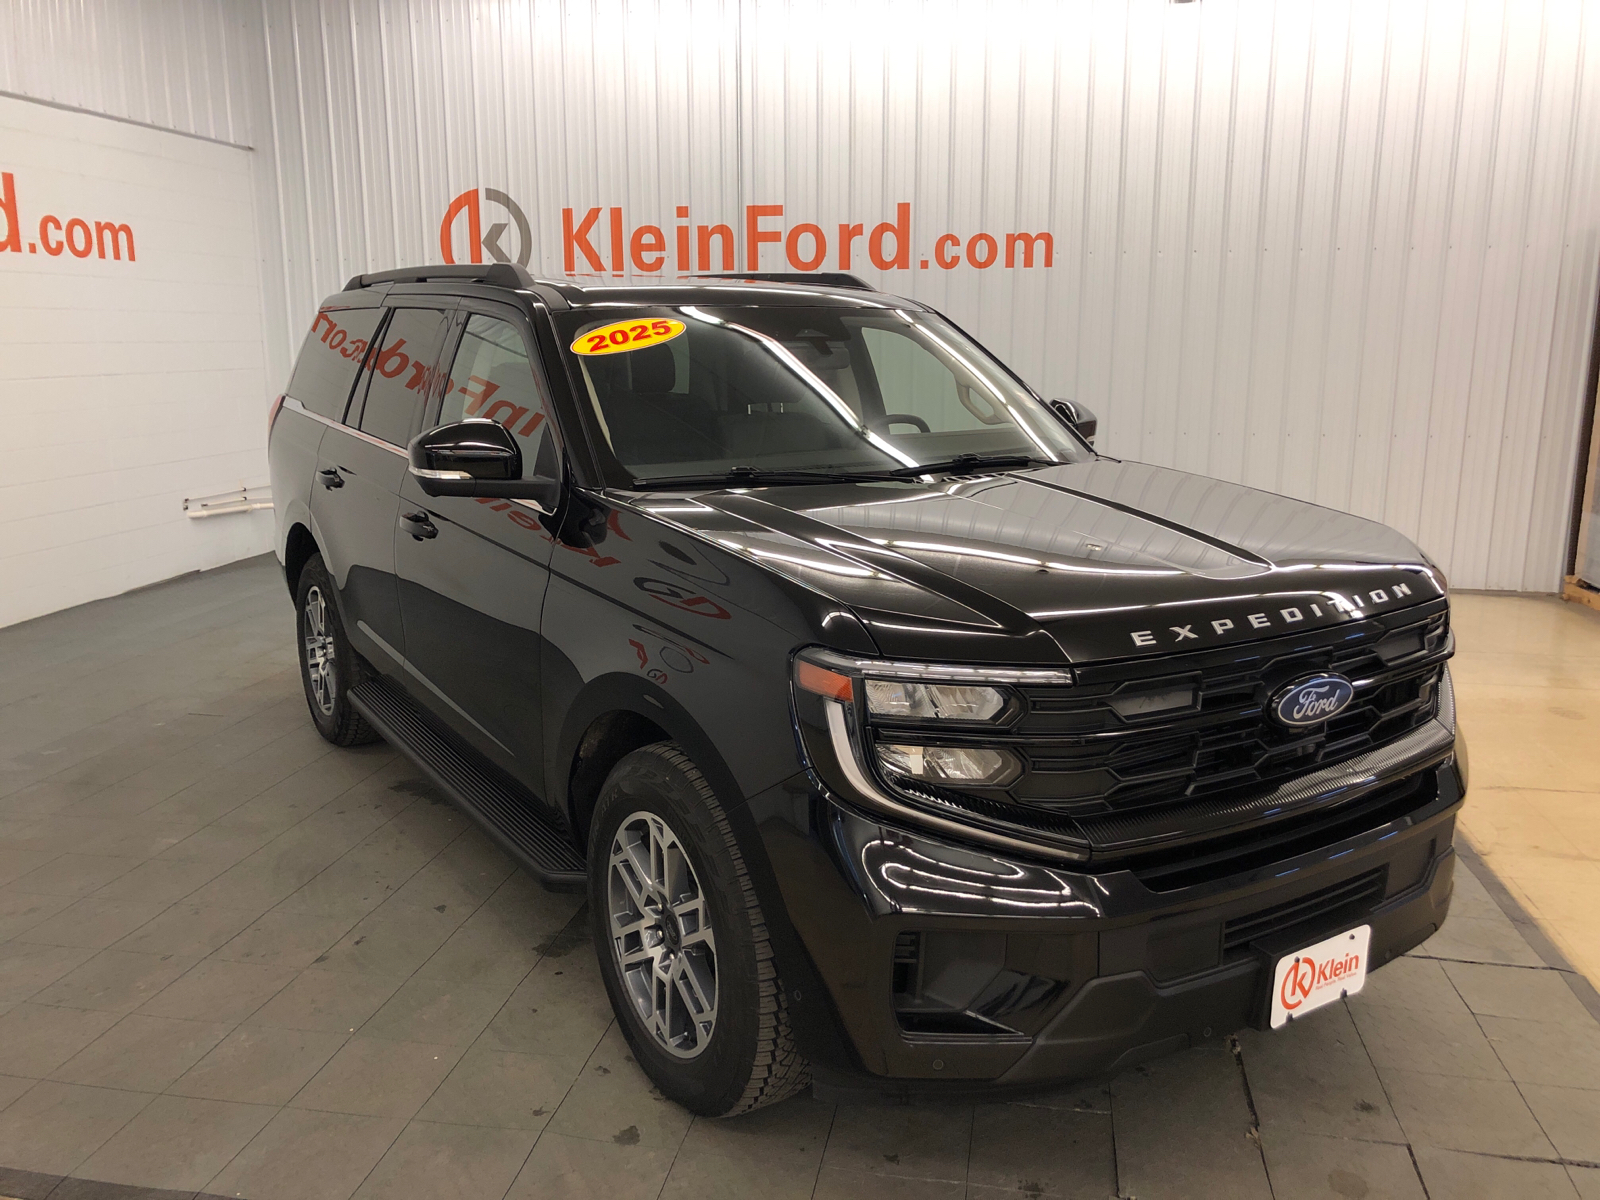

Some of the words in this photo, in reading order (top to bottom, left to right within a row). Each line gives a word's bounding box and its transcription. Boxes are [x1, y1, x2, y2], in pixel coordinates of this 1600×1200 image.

[562, 202, 1054, 271] KleinFord.com
[587, 320, 672, 352] 2025
[1130, 583, 1412, 647] EXPEDITION
[1293, 686, 1339, 719] Ford
[1317, 953, 1359, 984] Klein
